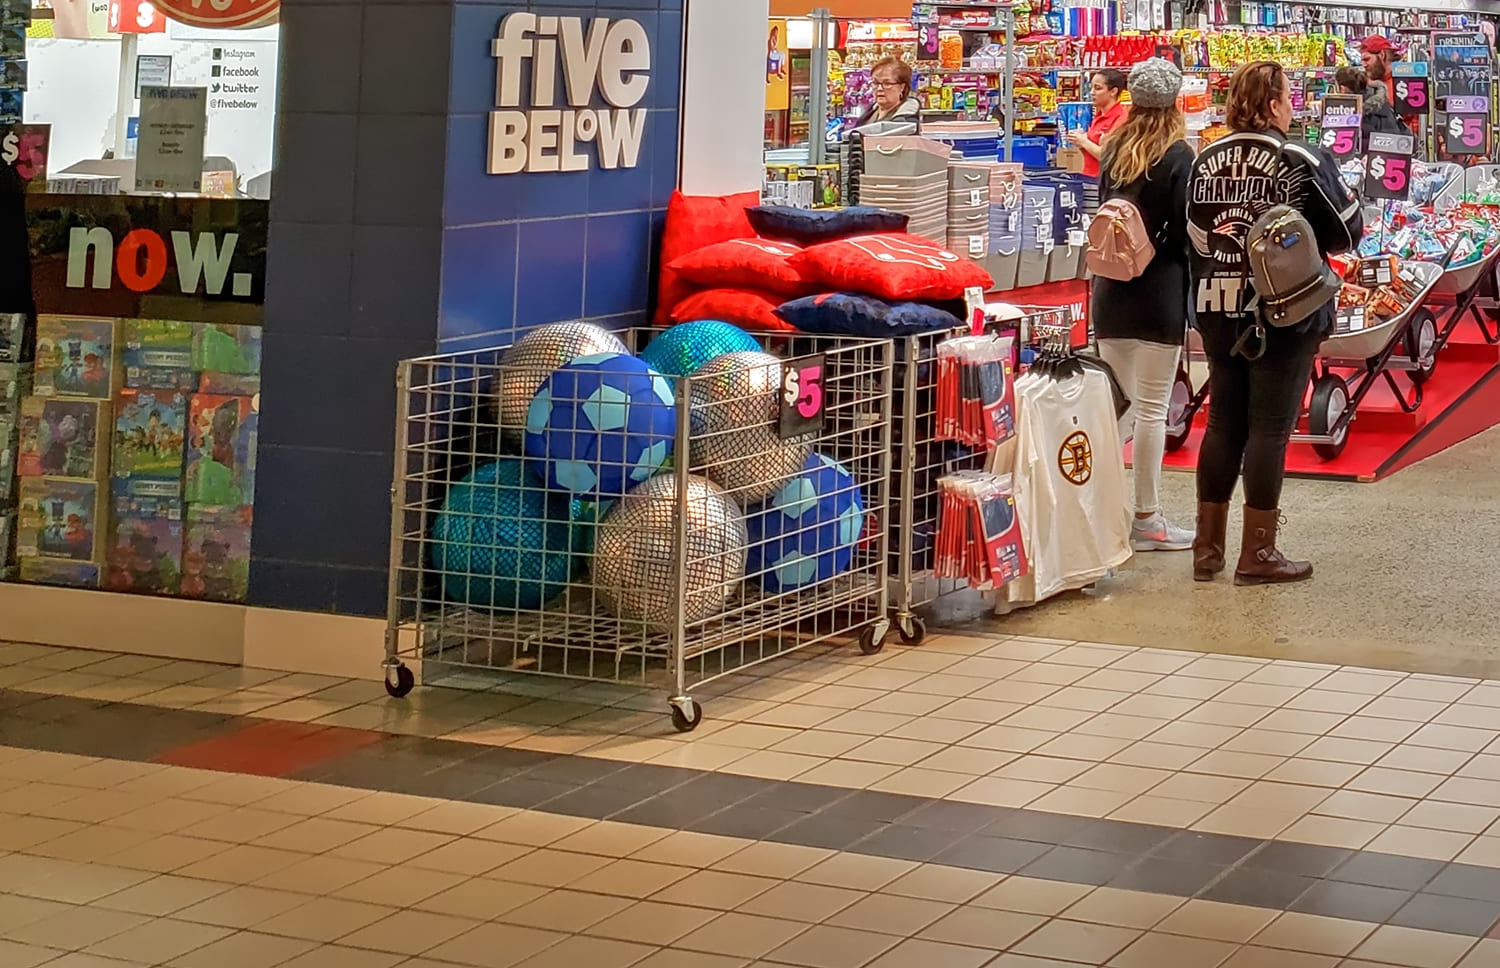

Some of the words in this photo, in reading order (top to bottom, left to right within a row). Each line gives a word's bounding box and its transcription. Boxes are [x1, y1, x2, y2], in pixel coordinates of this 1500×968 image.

[919, 28, 938, 54] $5
[222, 65, 260, 77] facebook
[489, 12, 652, 108] five
[222, 83, 260, 94] twitter
[1396, 80, 1426, 108] $5
[1326, 105, 1356, 116] enter
[486, 108, 648, 175] BELOW
[1323, 129, 1355, 154] $5
[1450, 116, 1484, 147] $5
[1, 130, 45, 180] $5
[1198, 146, 1242, 181] SUPER
[1369, 155, 1407, 191] $5
[1193, 175, 1291, 204] CHAMPIONS
[64, 224, 253, 299] now.
[783, 365, 822, 419] $5
